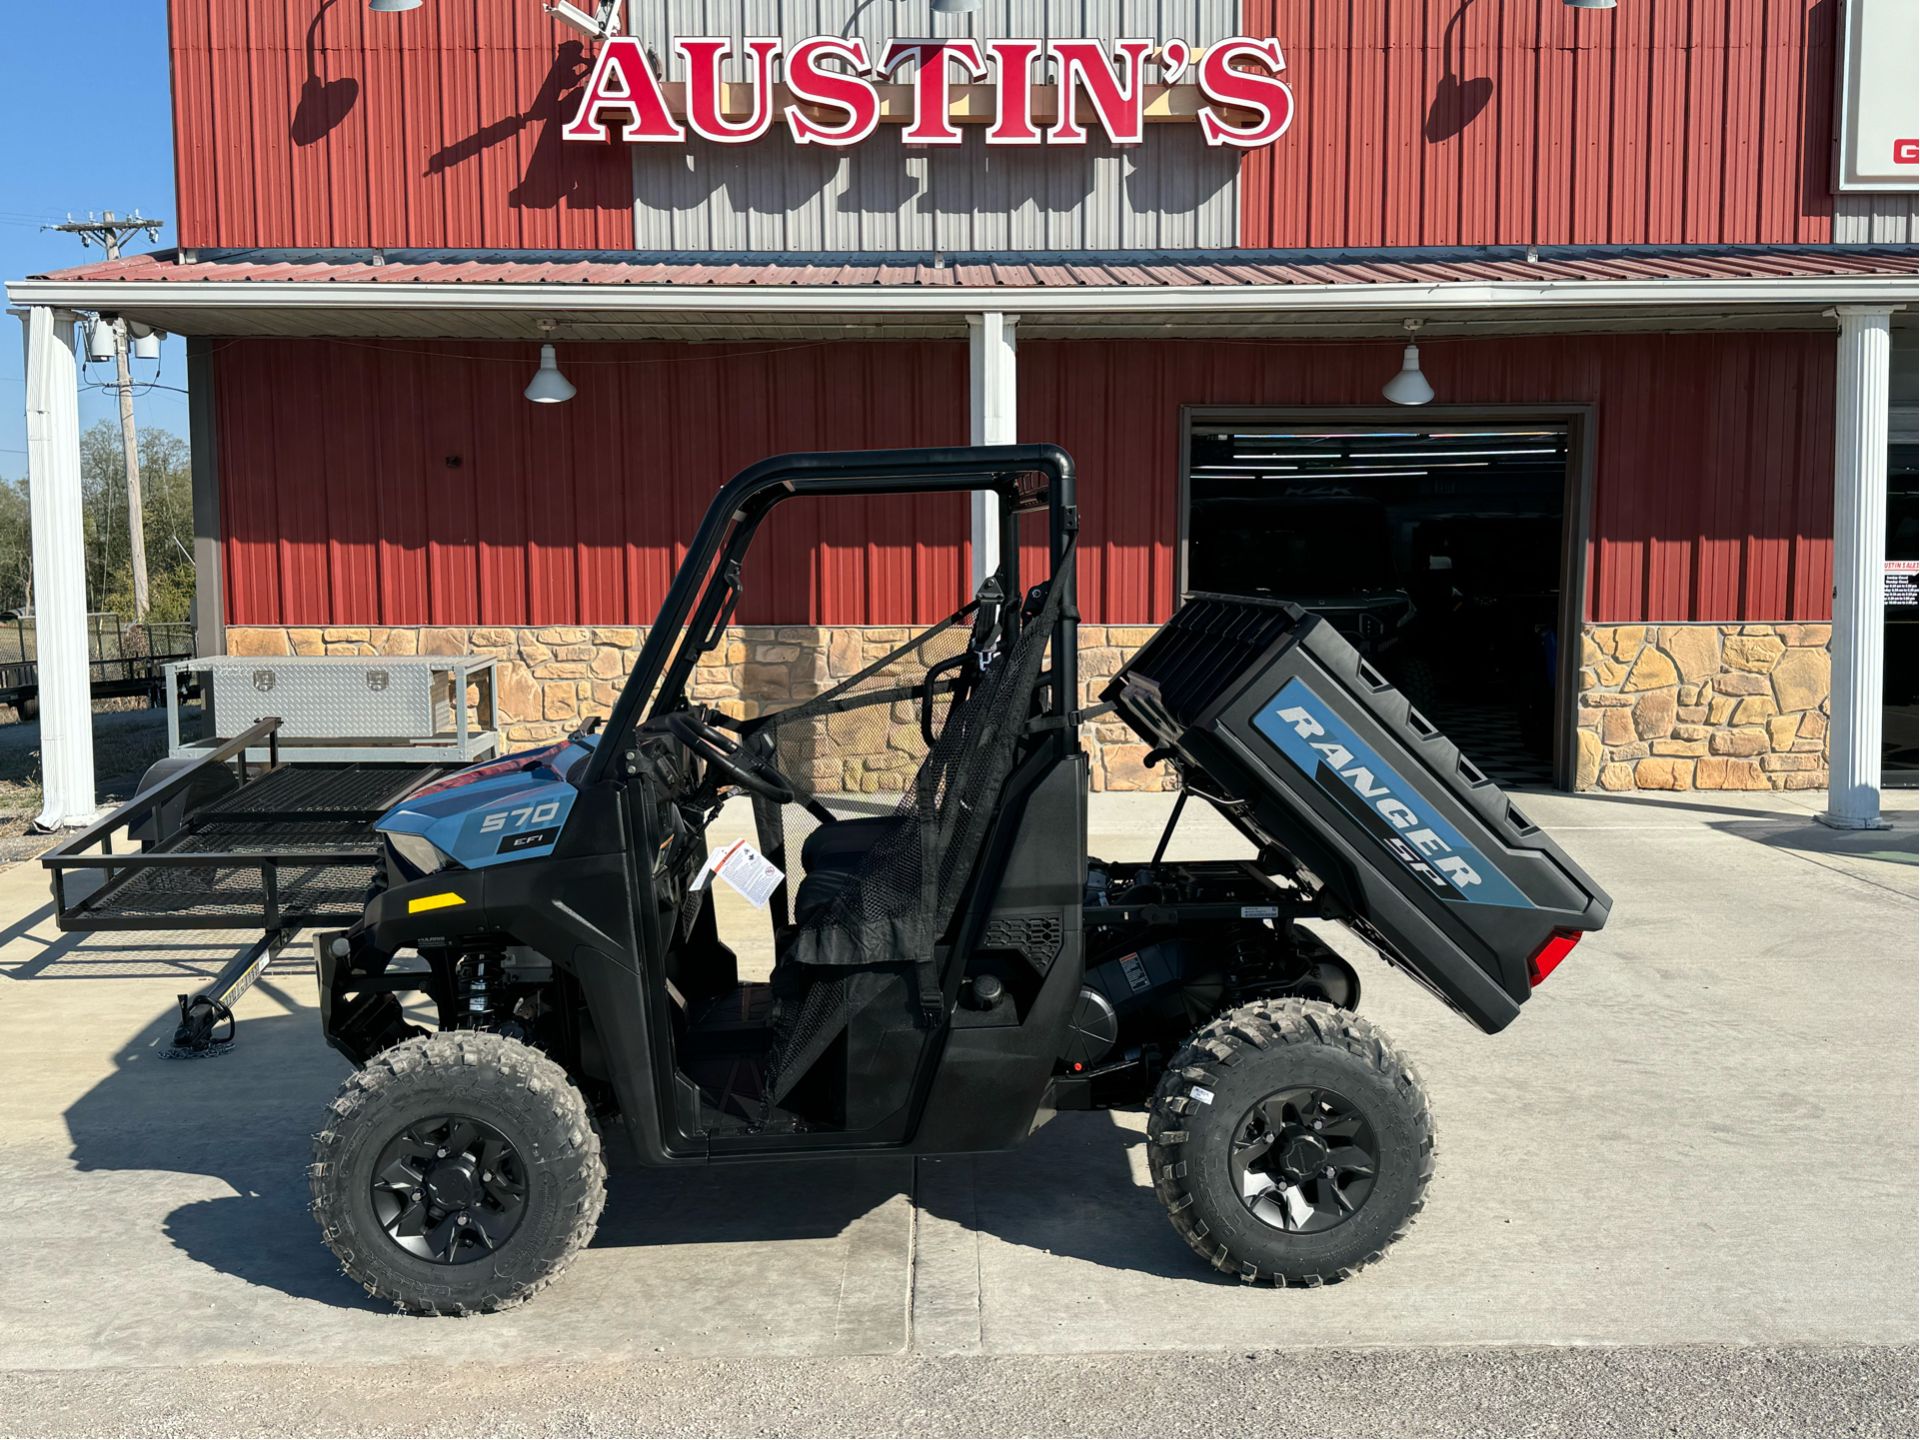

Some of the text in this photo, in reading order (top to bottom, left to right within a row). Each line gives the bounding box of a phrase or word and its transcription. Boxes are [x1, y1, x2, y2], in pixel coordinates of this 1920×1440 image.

[562, 35, 1294, 148] AUSTIN'S
[1893, 138, 1919, 165] G
[1276, 706, 1482, 888] RANGER
[480, 802, 560, 834] 570
[513, 834, 544, 846] EFI
[1383, 838, 1448, 887] SP
